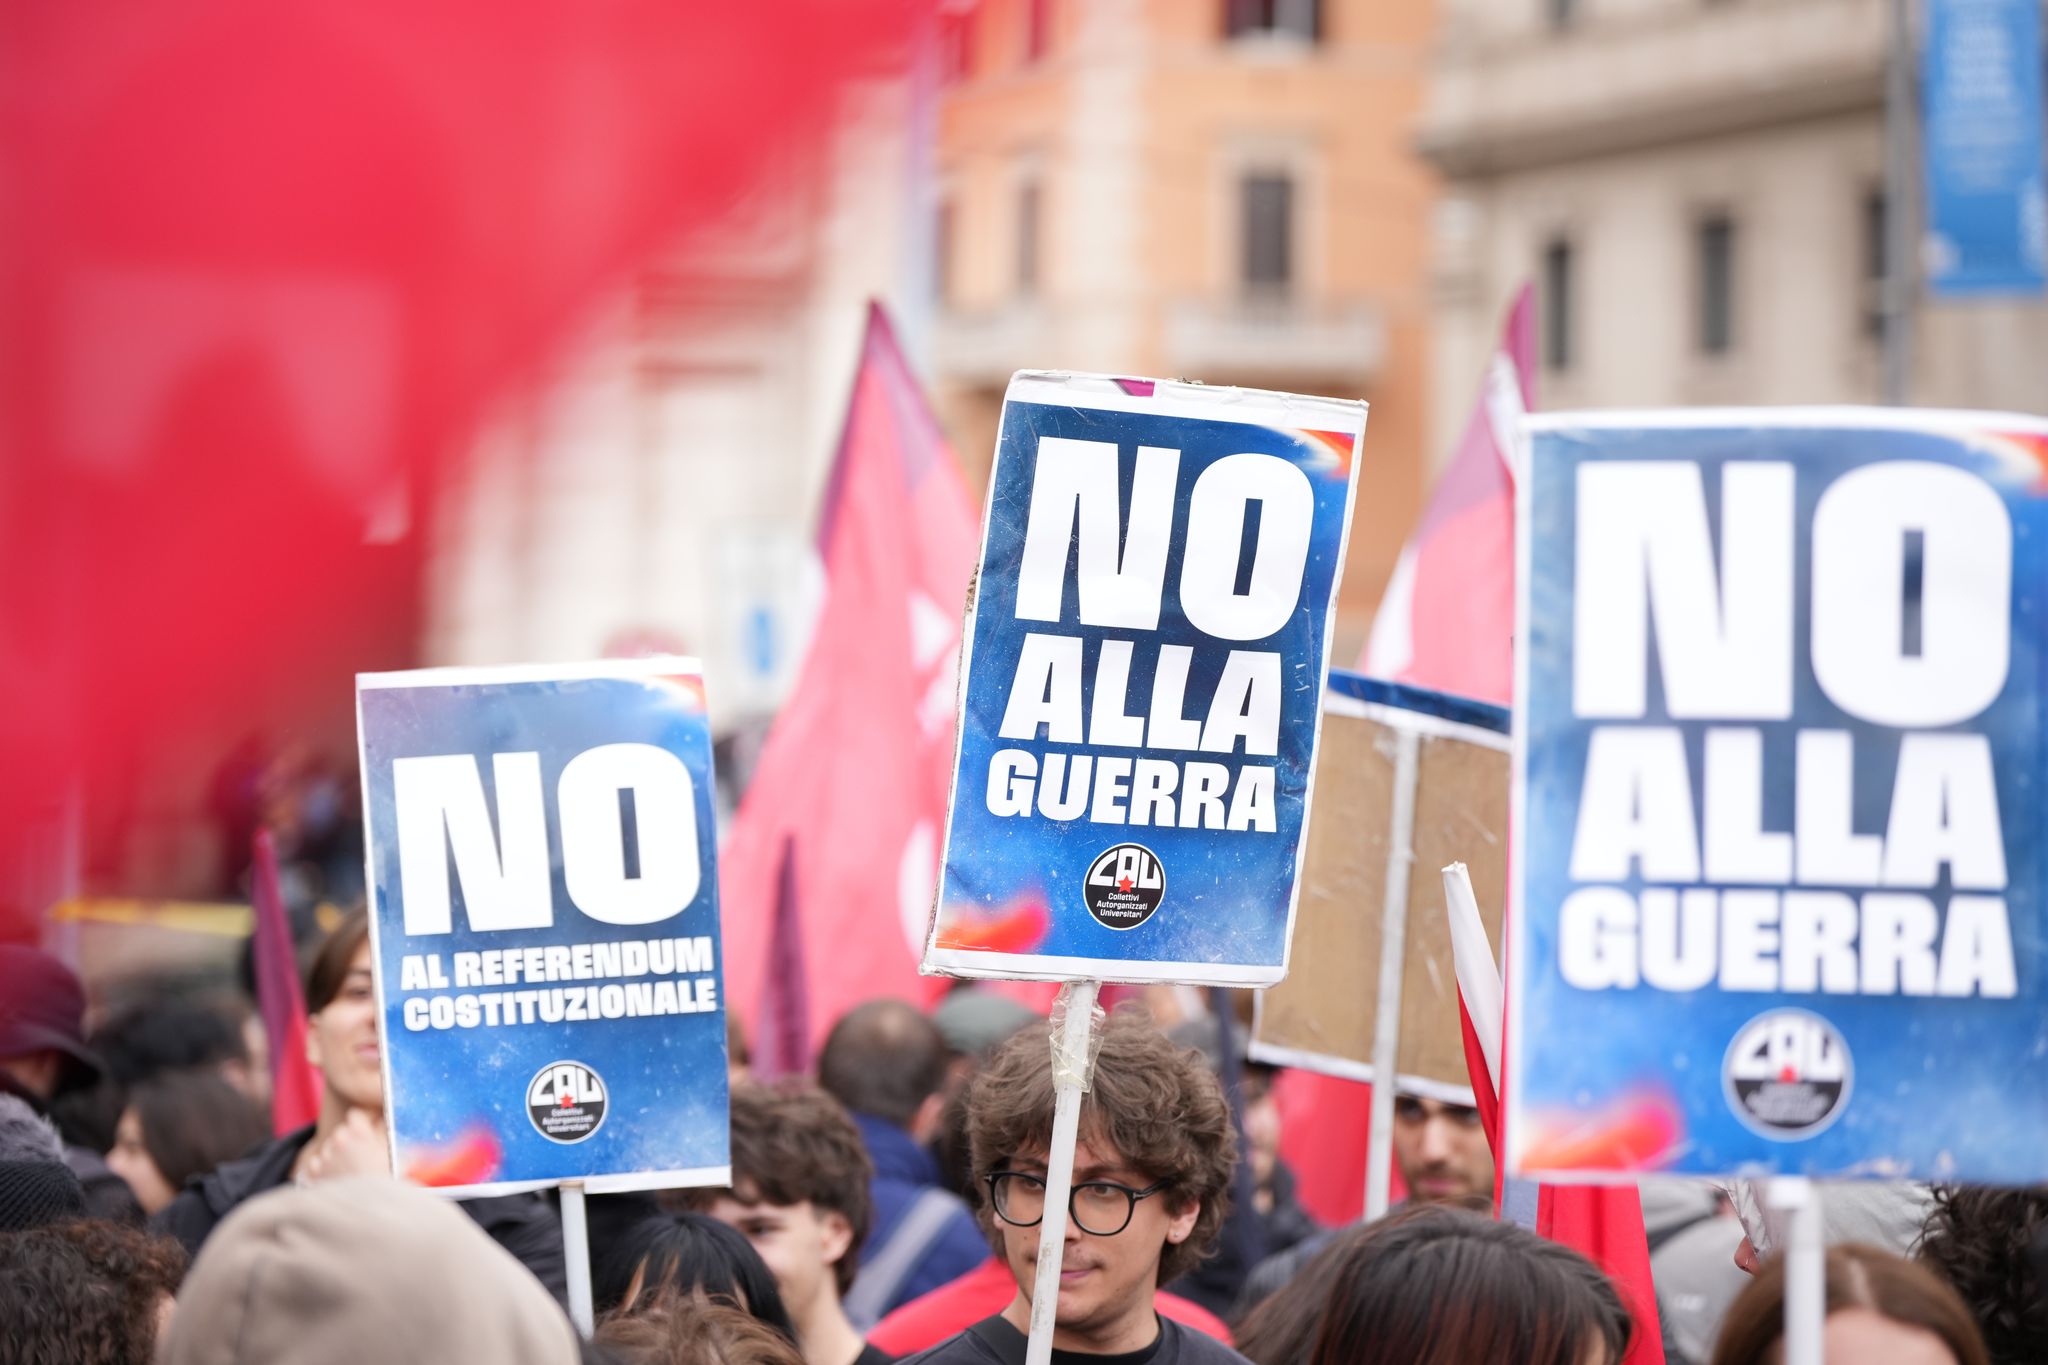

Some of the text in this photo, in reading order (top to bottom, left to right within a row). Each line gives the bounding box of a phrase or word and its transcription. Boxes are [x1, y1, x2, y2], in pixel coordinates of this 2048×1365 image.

[1024, 437, 1314, 640] NO
[1573, 461, 2011, 726] NO
[999, 633, 1281, 756] ALLA
[986, 749, 1277, 832] GUERRA
[1570, 728, 2007, 889] ALLA
[393, 743, 700, 935] NO
[1089, 848, 1161, 889] CAU
[1096, 900, 1148, 910] Autorganizzati
[1100, 909, 1142, 918] Universitari
[1108, 892, 1139, 901] Collettivi
[401, 936, 714, 991] AL REFERENDUM
[1559, 887, 2017, 997] GUERRA
[403, 978, 717, 1032] COSTITUZIONALE
